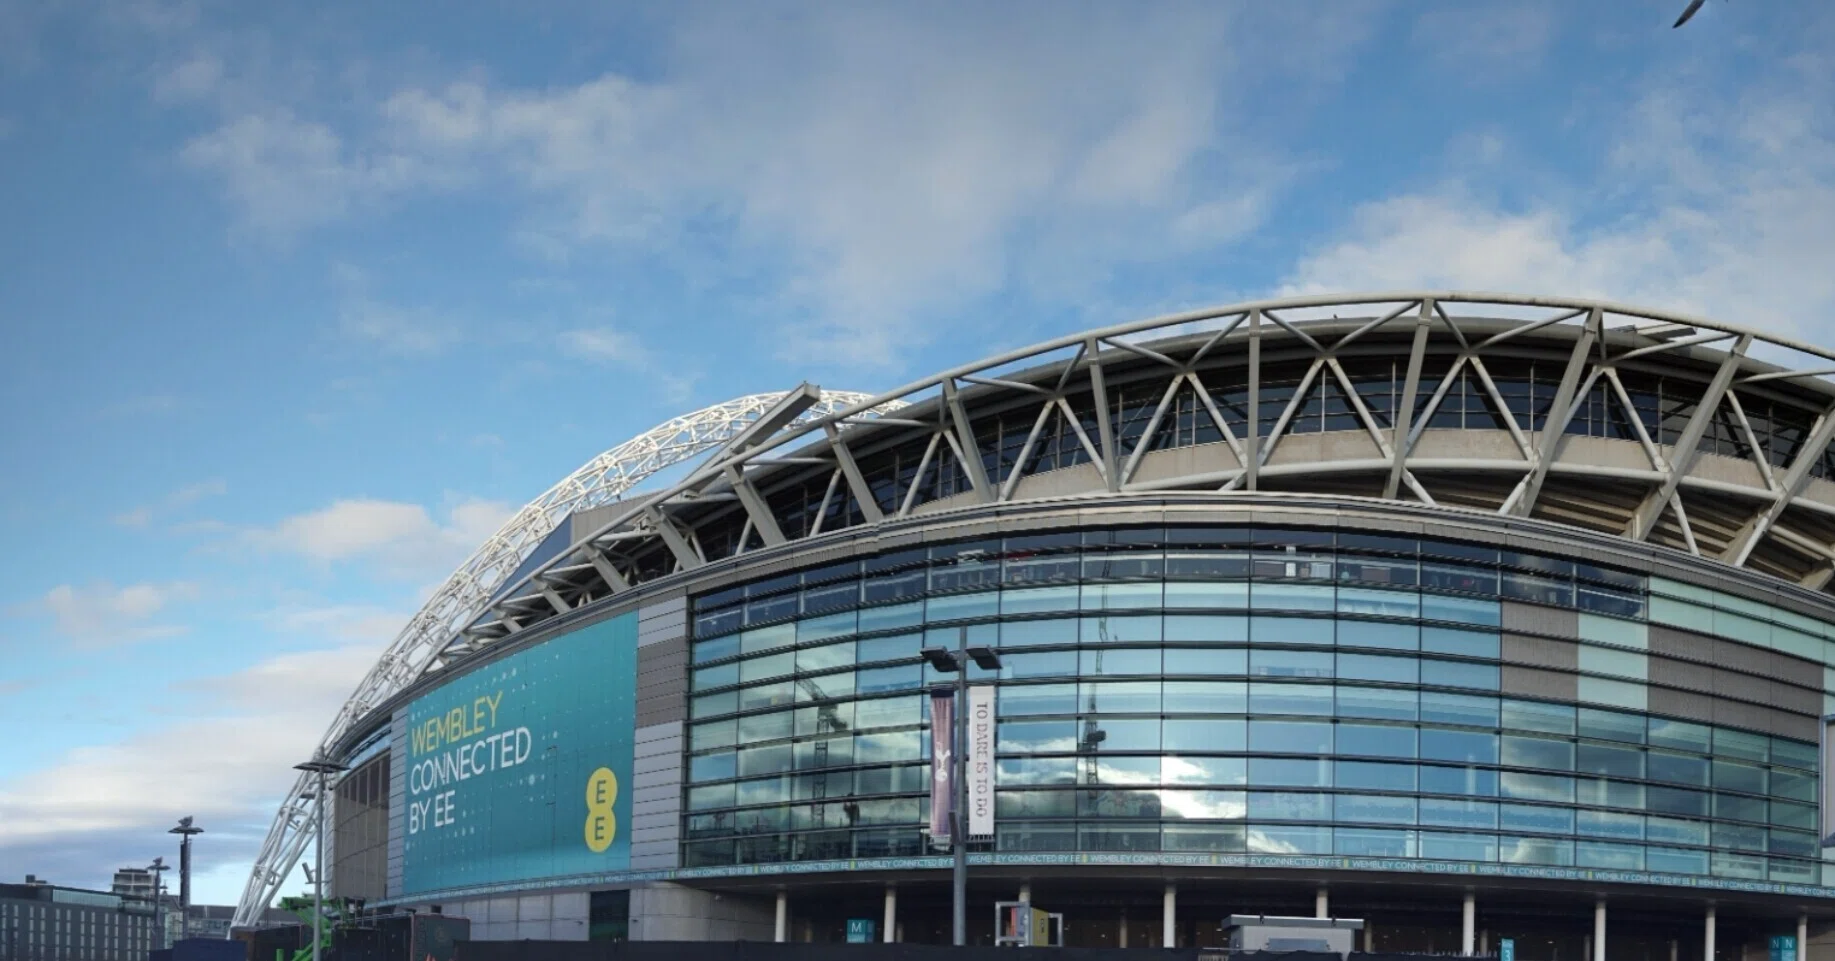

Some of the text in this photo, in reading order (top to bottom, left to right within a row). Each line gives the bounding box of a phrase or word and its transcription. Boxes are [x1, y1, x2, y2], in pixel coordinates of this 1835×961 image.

[412, 690, 503, 758] WEMBLEY
[411, 727, 531, 795] CONNECTED
[975, 703, 988, 817] TO DARE IS TO DO
[410, 790, 456, 834] BY EE
[1008, 854, 1057, 863] CONNECTED
[1058, 854, 1068, 863] BY
[1090, 855, 1132, 863] WEMBLEY
[1186, 855, 1197, 863] BY
[1220, 856, 1261, 864] WEMBEY
[1263, 856, 1317, 866] CONNECTED
[1318, 858, 1330, 867] BY
[1352, 860, 1394, 869] WEMBLEY
[1447, 864, 1457, 873] BY
[851, 922, 862, 933] M
[1785, 938, 1793, 949] N
